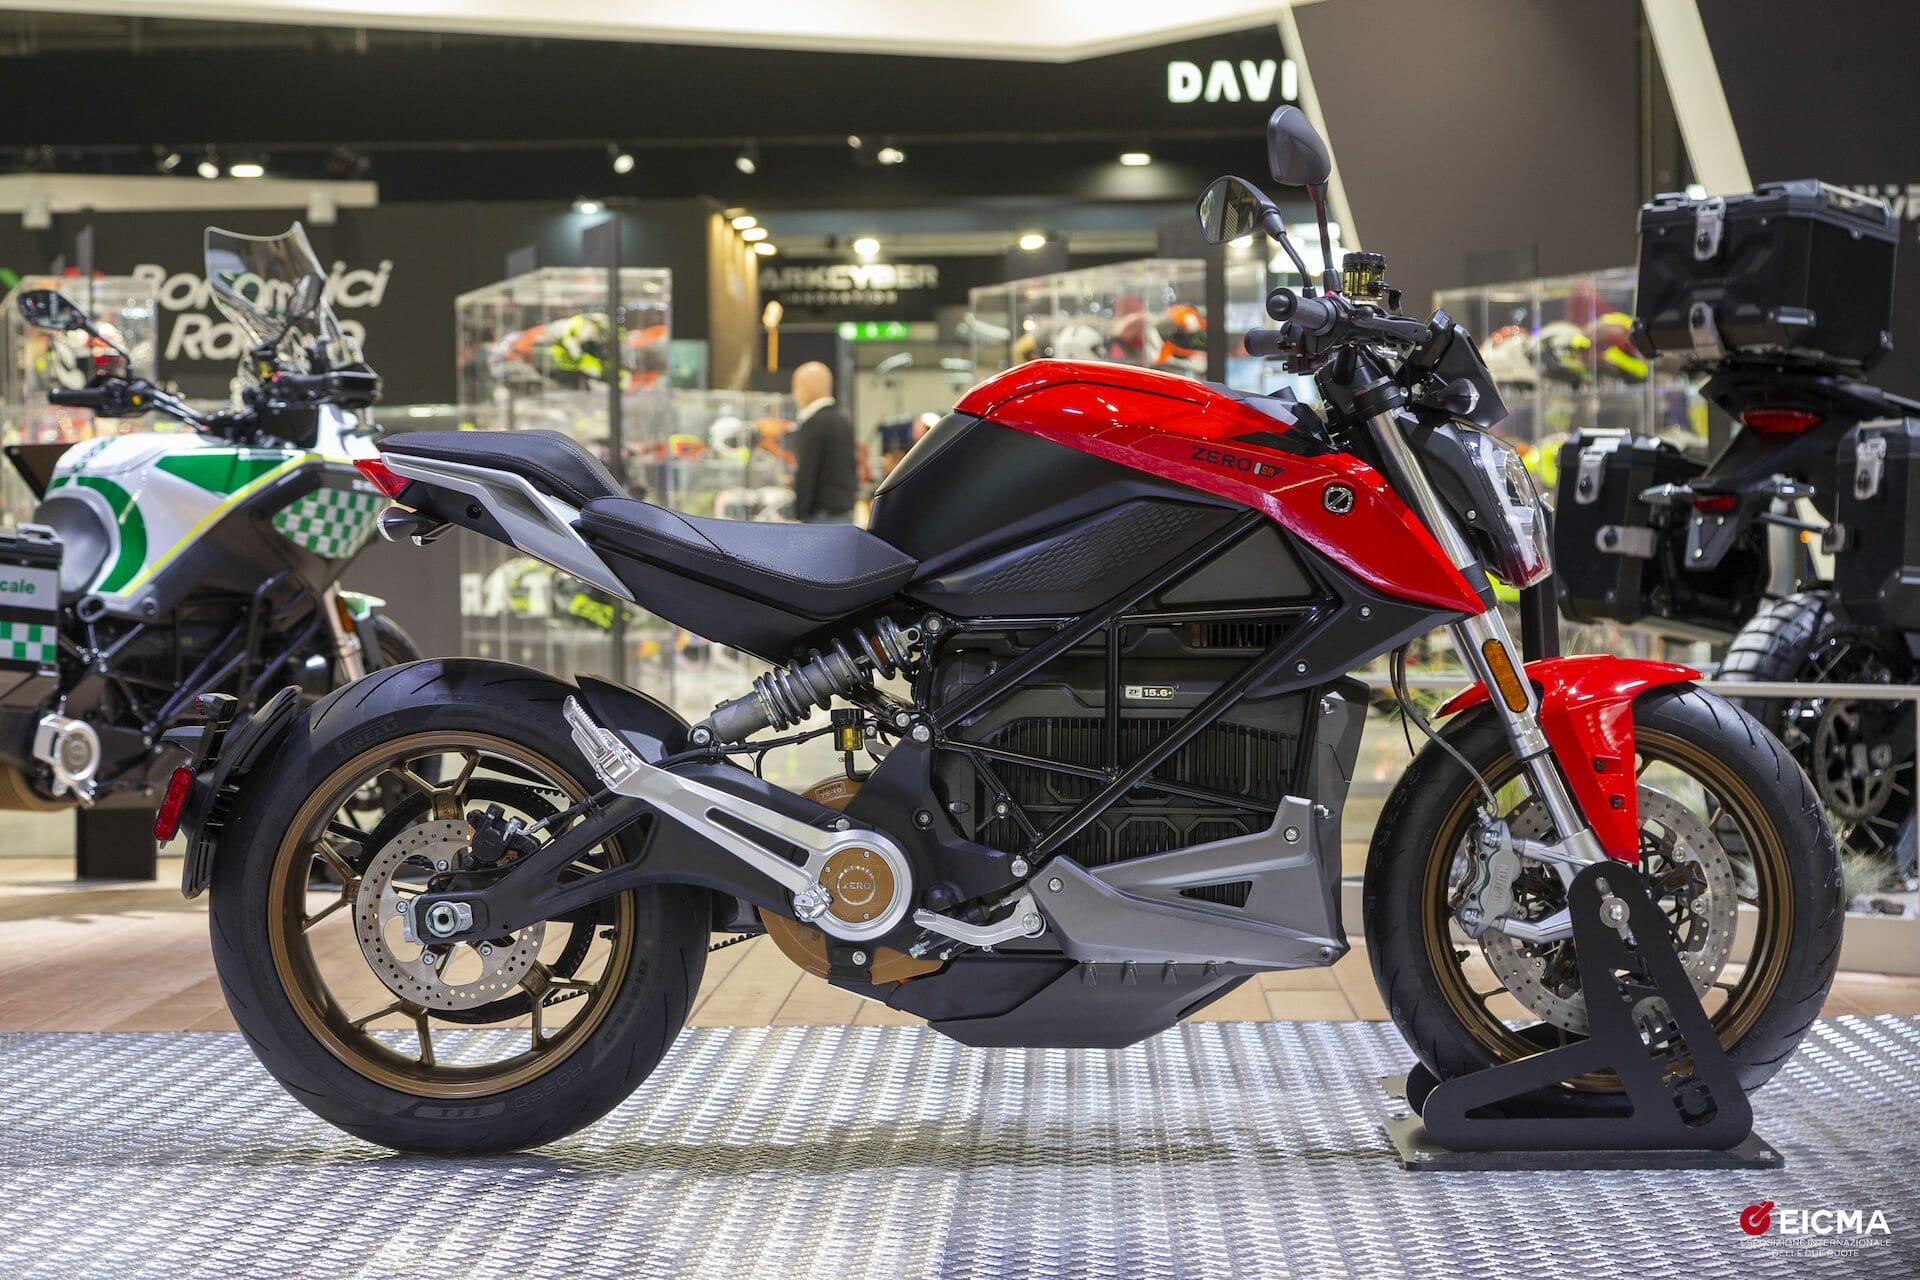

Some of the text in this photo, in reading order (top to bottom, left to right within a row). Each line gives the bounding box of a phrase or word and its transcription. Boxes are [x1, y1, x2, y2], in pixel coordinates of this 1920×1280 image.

[1167, 59, 1298, 103] DAVI
[1190, 446, 1252, 472] ZERO
[843, 882, 871, 890] ZERO
